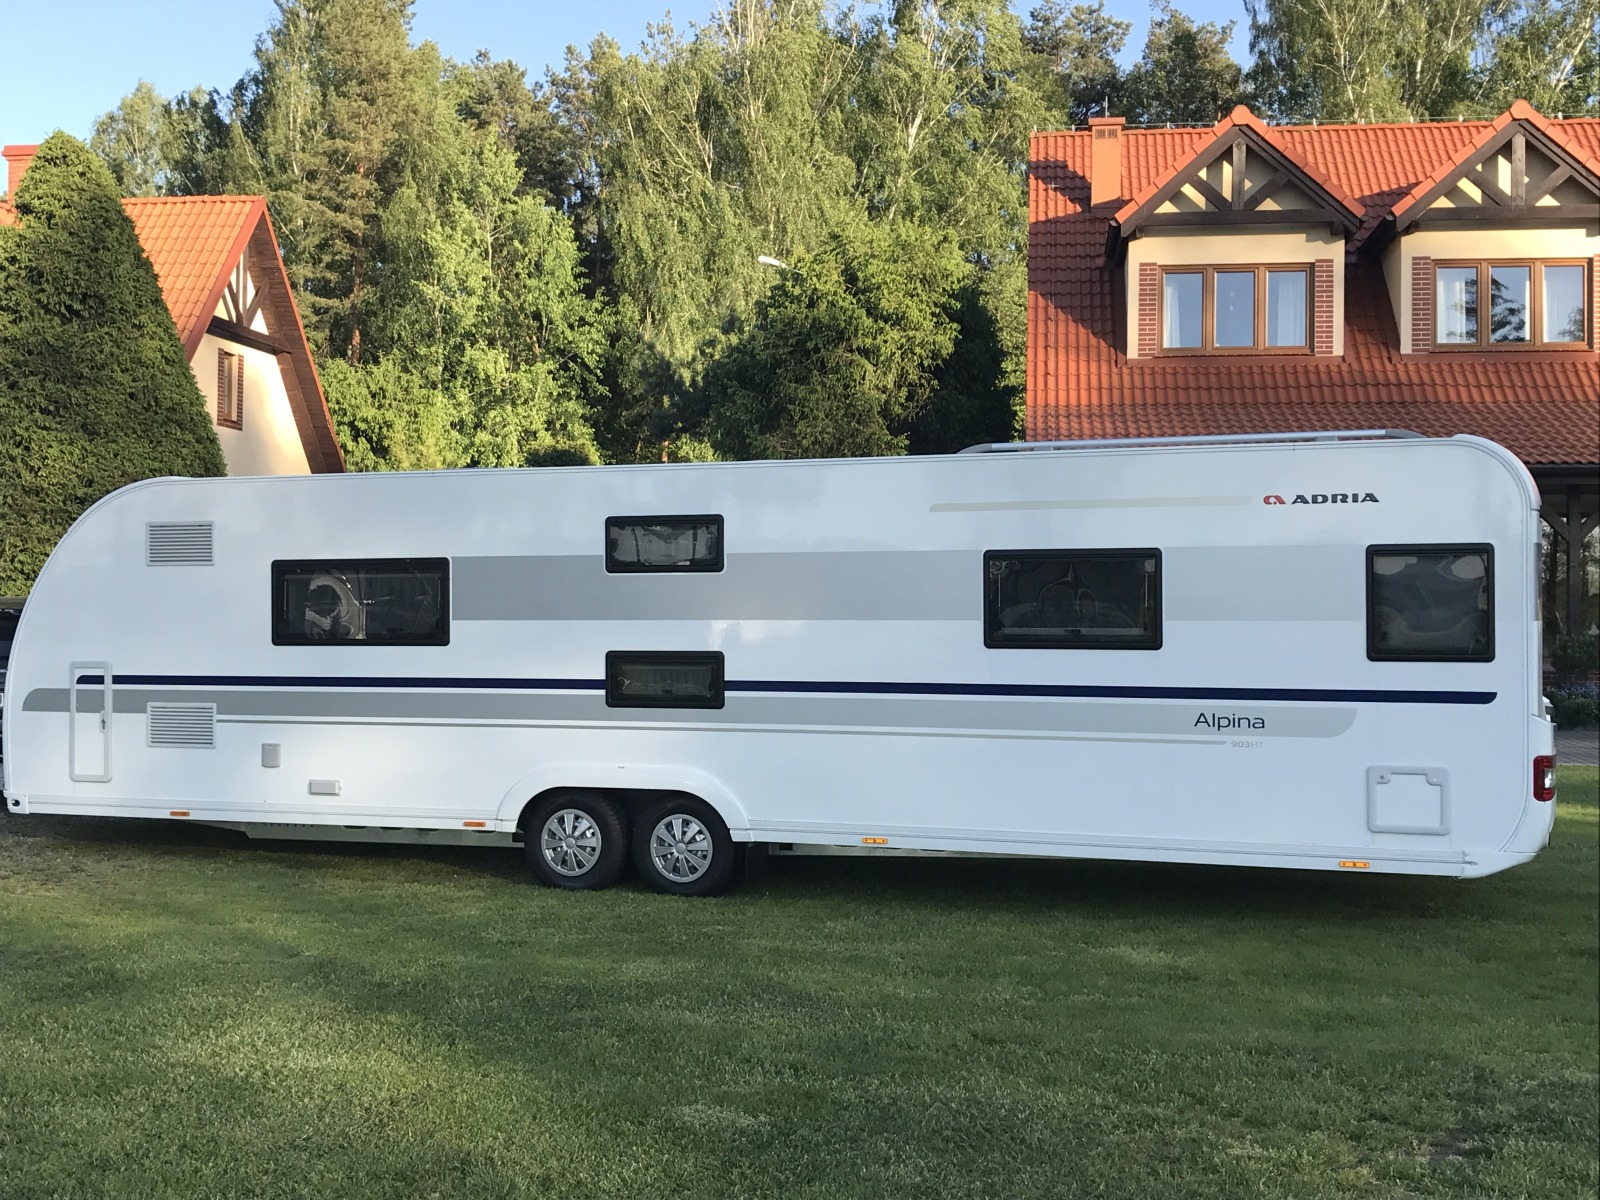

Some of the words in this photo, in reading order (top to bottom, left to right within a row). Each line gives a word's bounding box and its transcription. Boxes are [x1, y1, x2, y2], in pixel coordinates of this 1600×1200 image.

[1291, 493, 1380, 504] ADRIA
[1194, 712, 1265, 731] Alpina
[1230, 740, 1264, 748] 903HT
